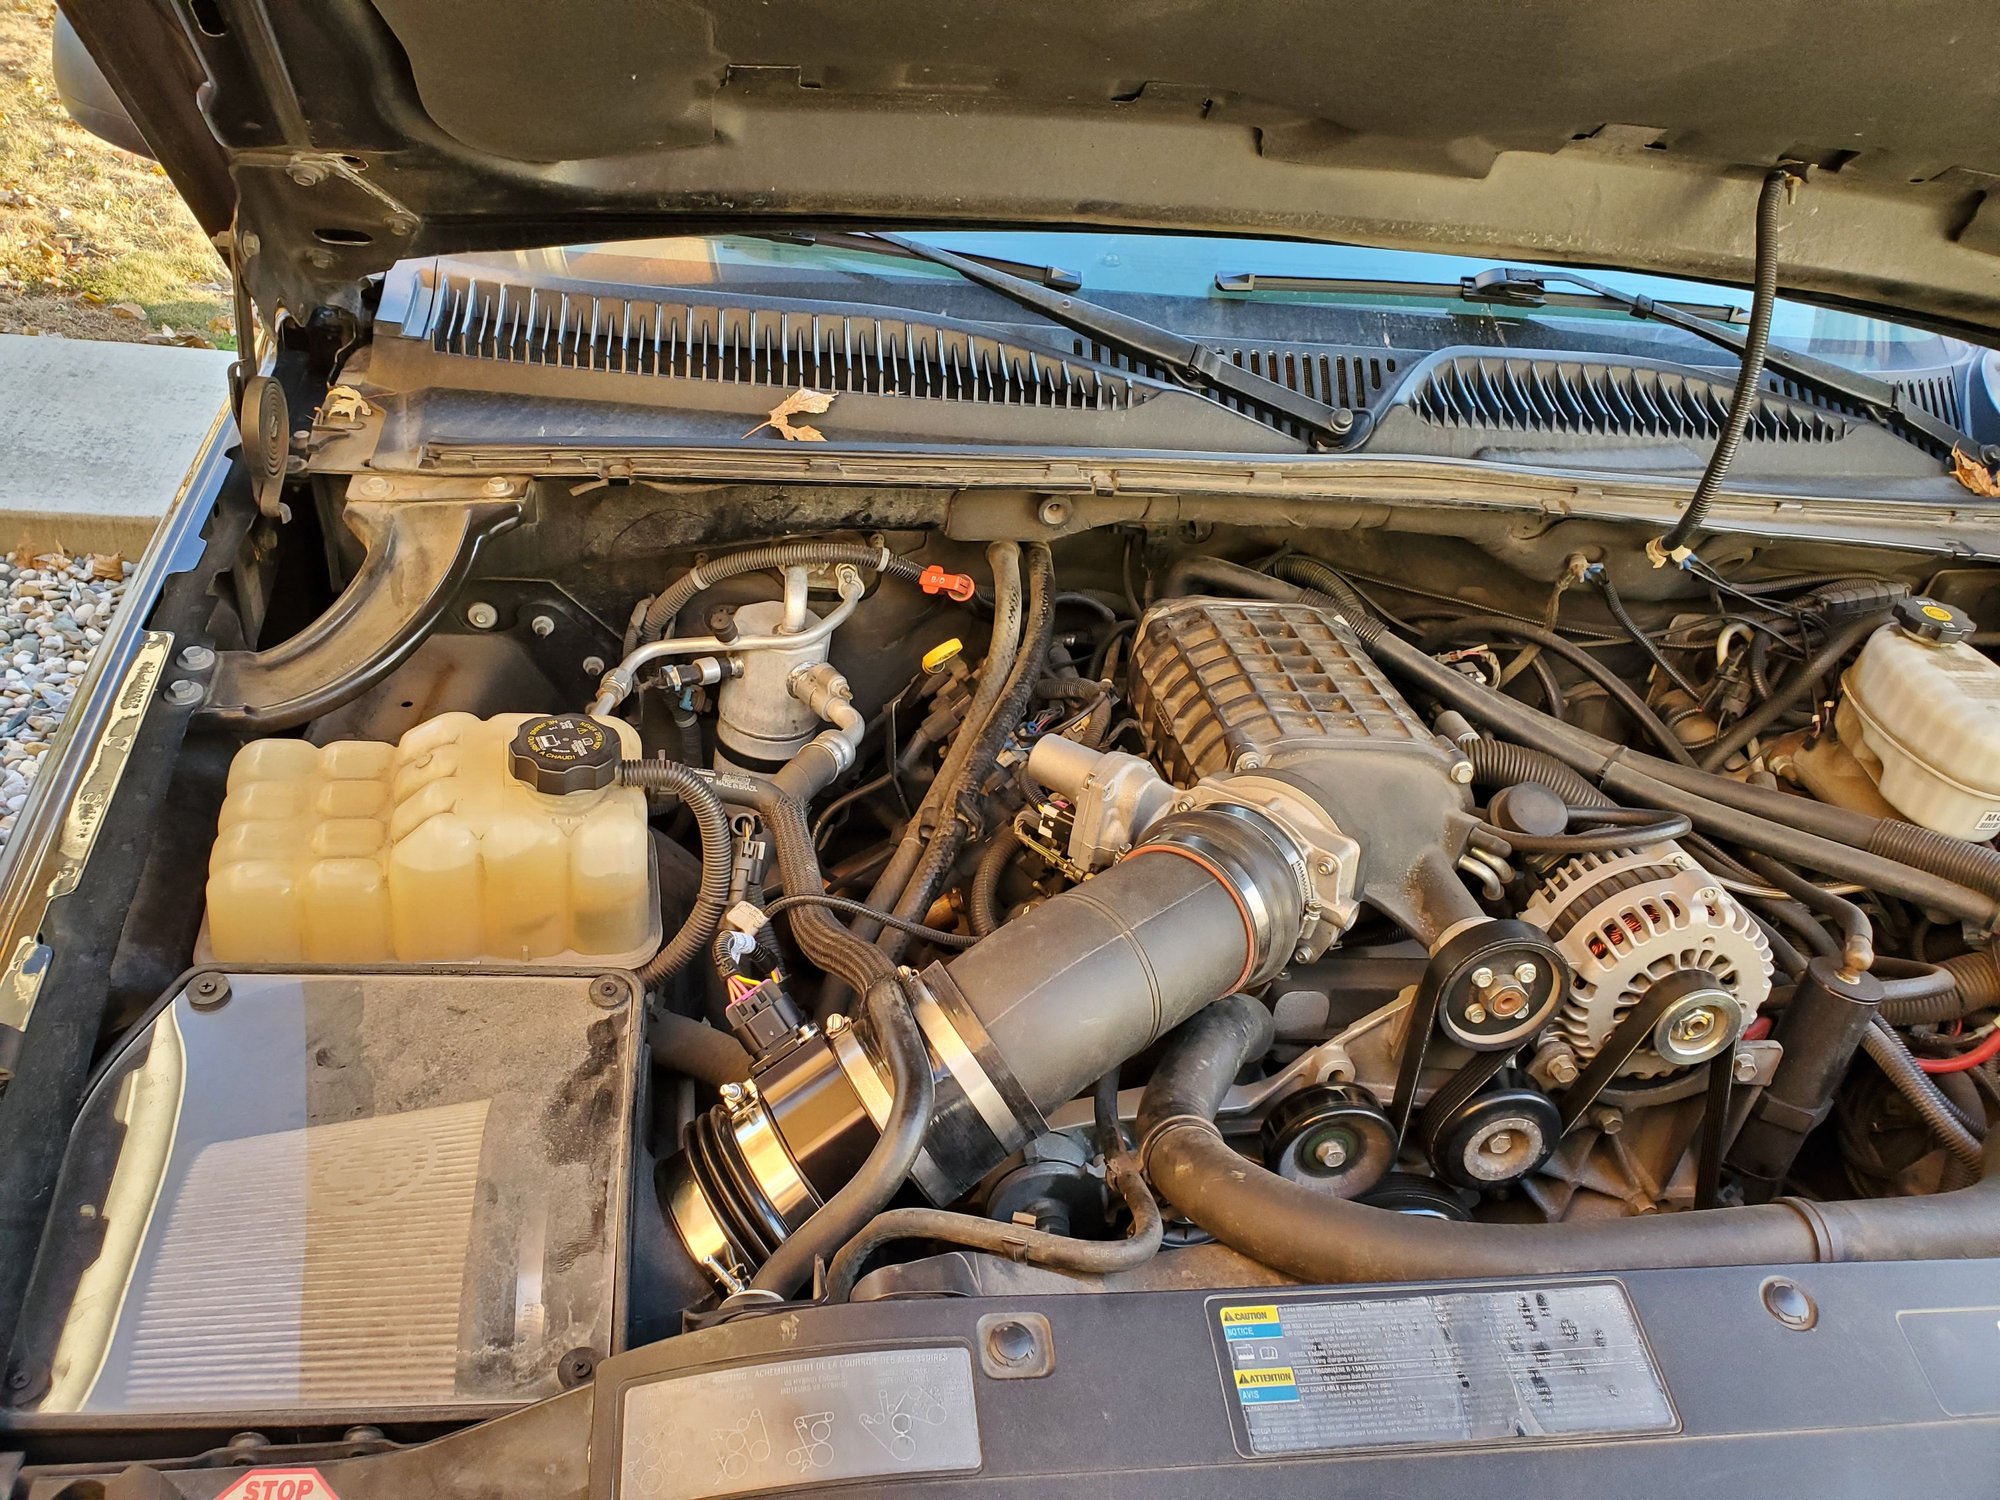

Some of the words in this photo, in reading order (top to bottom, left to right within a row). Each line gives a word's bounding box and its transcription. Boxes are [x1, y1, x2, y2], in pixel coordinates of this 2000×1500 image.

[1234, 1311, 1267, 1321] CAUTION
[1227, 1326, 1254, 1336] NOTICE
[1250, 1373, 1292, 1384] ATTENTION
[1241, 1390, 1260, 1400] AVIS
[242, 1480, 314, 1500] STOP
